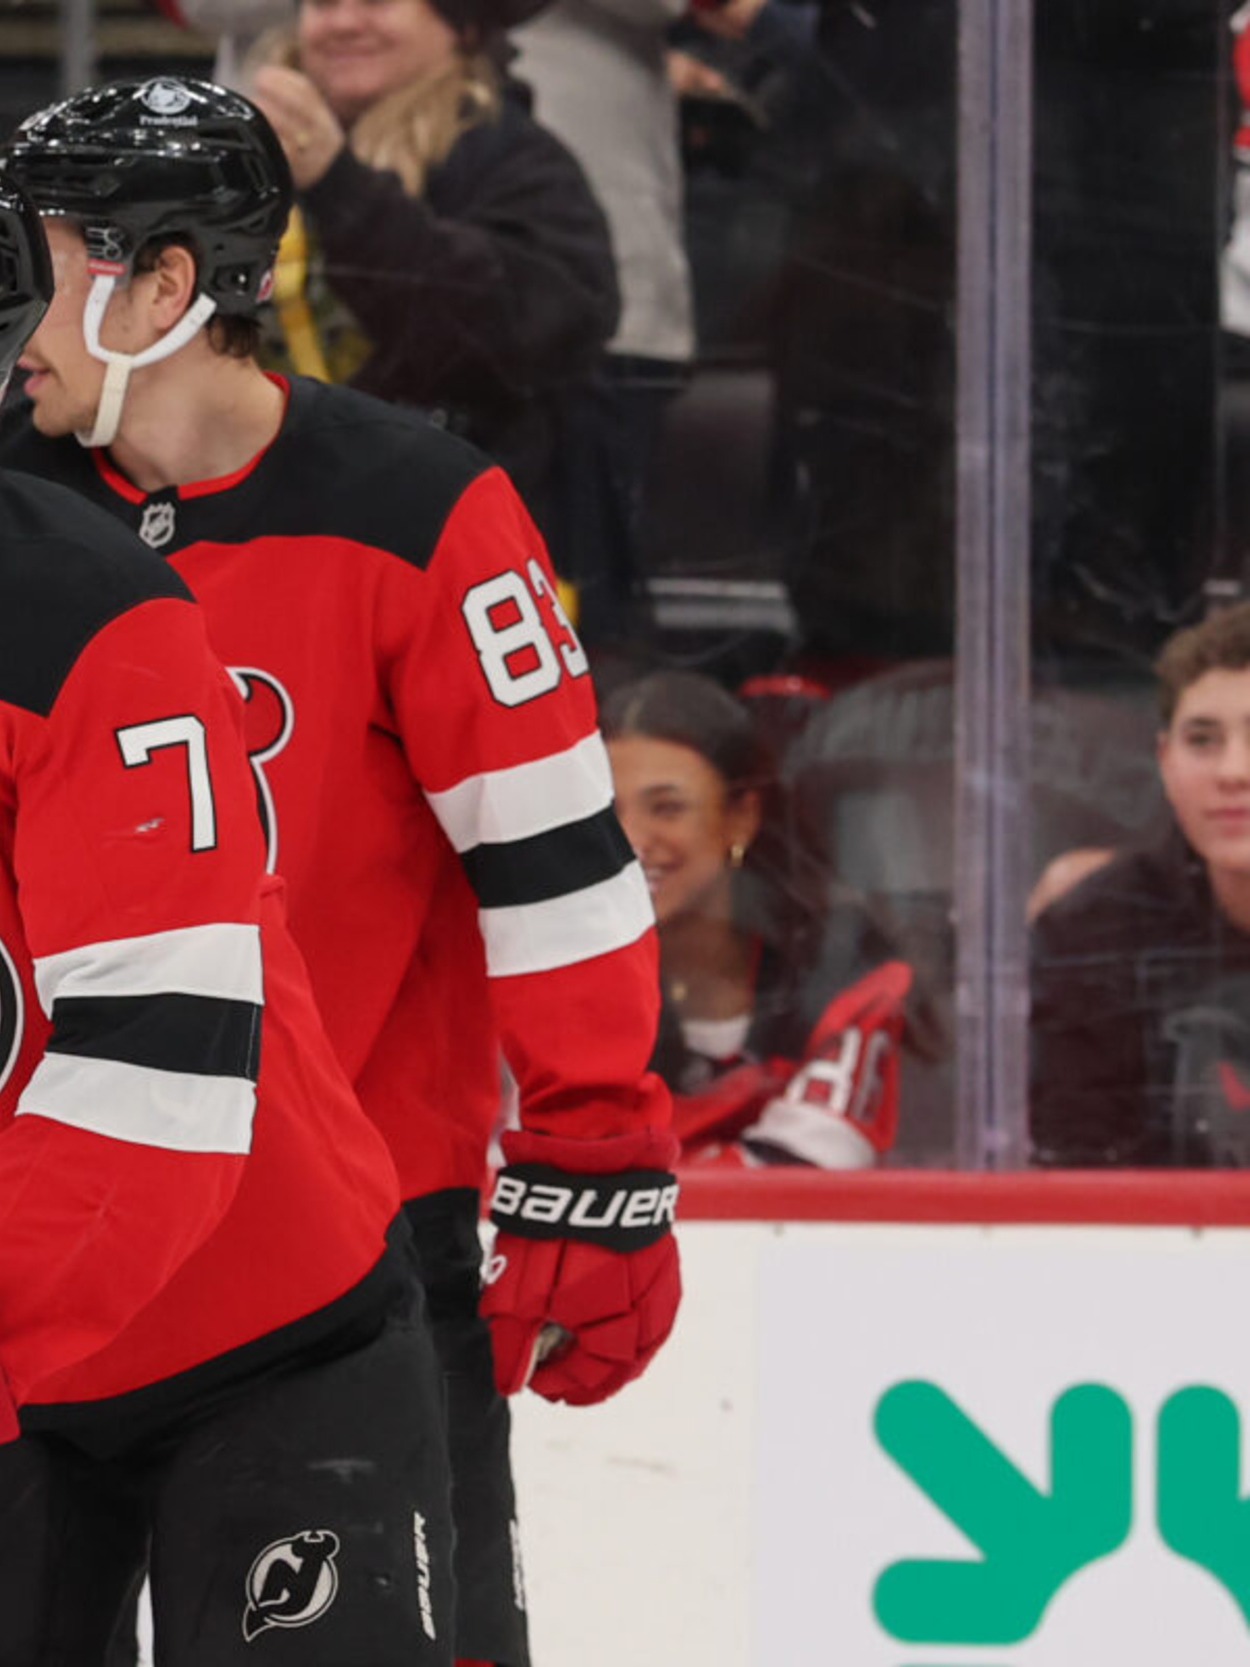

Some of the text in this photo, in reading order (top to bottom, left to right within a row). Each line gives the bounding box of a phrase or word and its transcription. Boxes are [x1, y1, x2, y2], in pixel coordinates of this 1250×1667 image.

[460, 556, 591, 709] 83
[114, 713, 218, 853] 7
[491, 1175, 680, 1229] BAUER
